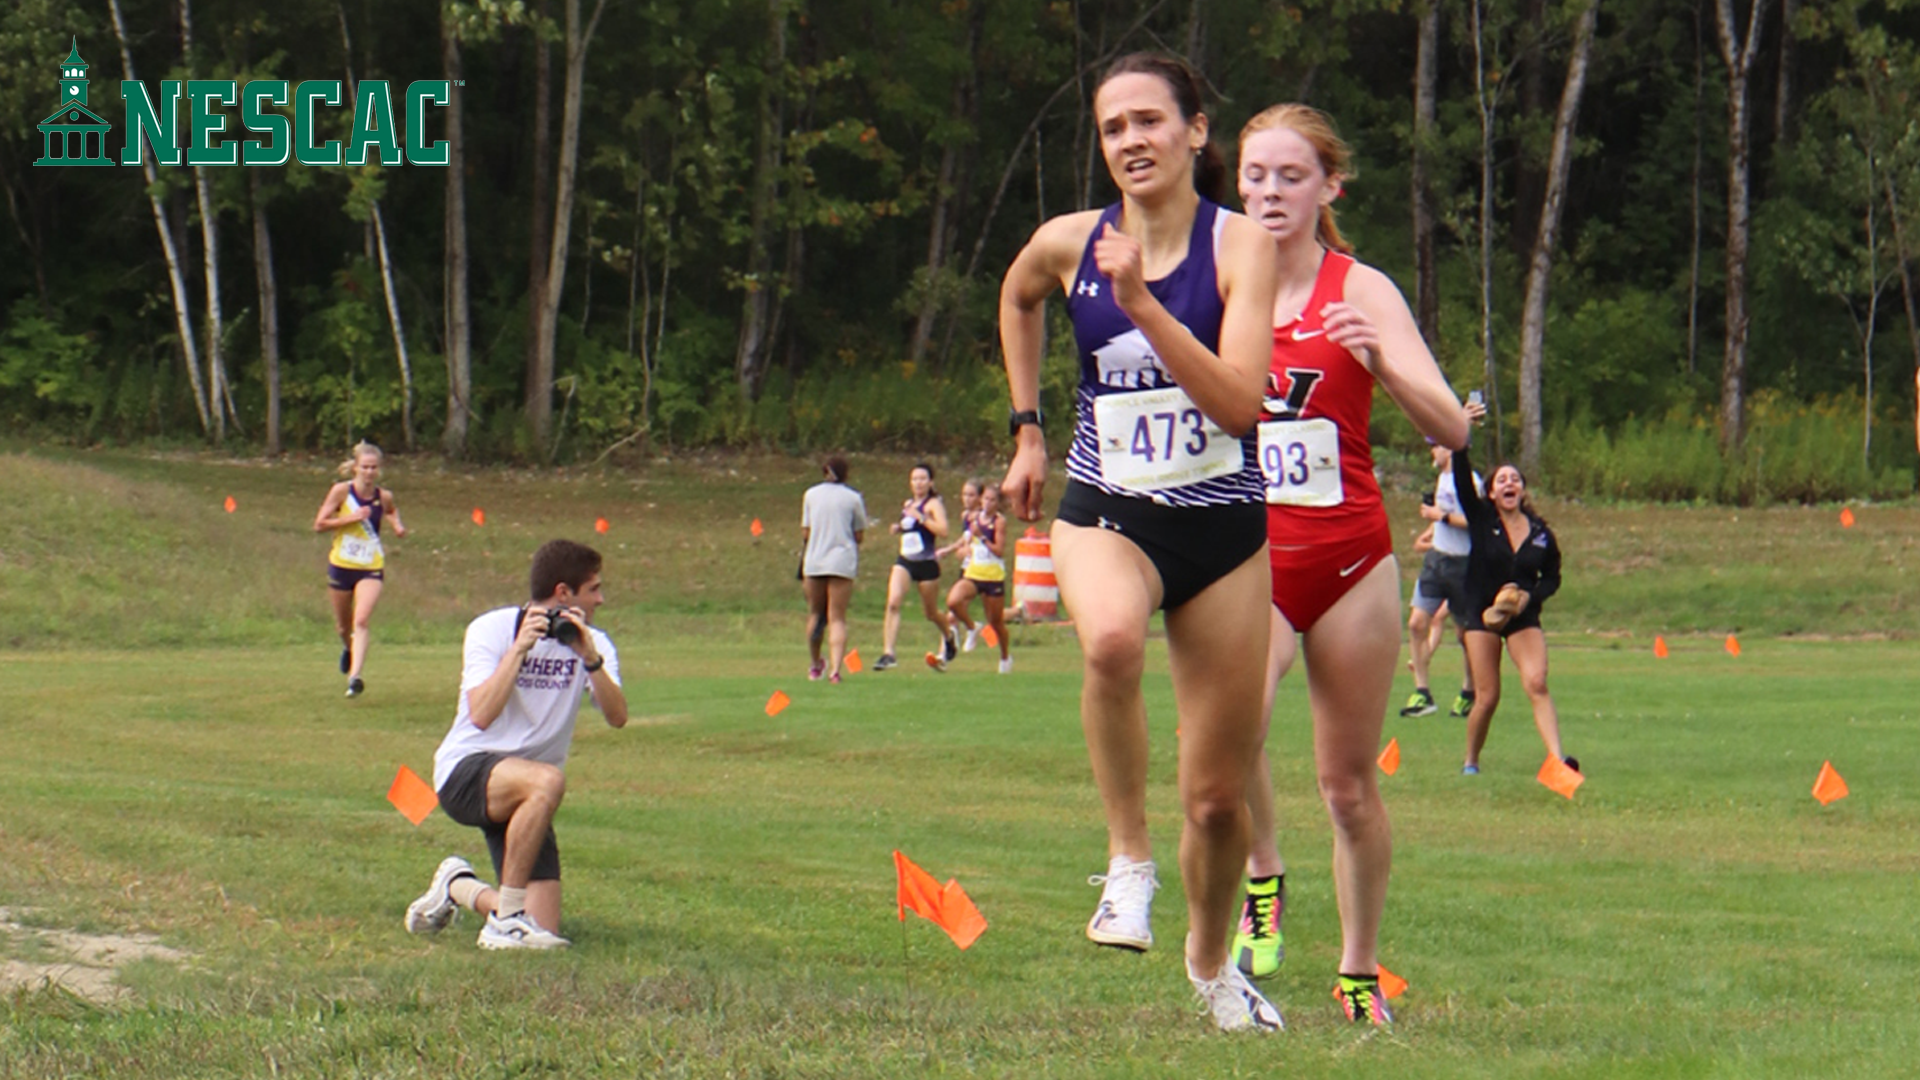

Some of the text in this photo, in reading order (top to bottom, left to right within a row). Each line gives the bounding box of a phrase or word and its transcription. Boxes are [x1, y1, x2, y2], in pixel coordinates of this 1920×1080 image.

[1131, 407, 1209, 463] 473
[518, 656, 578, 676] MHERST
[516, 677, 533, 688] OSS
